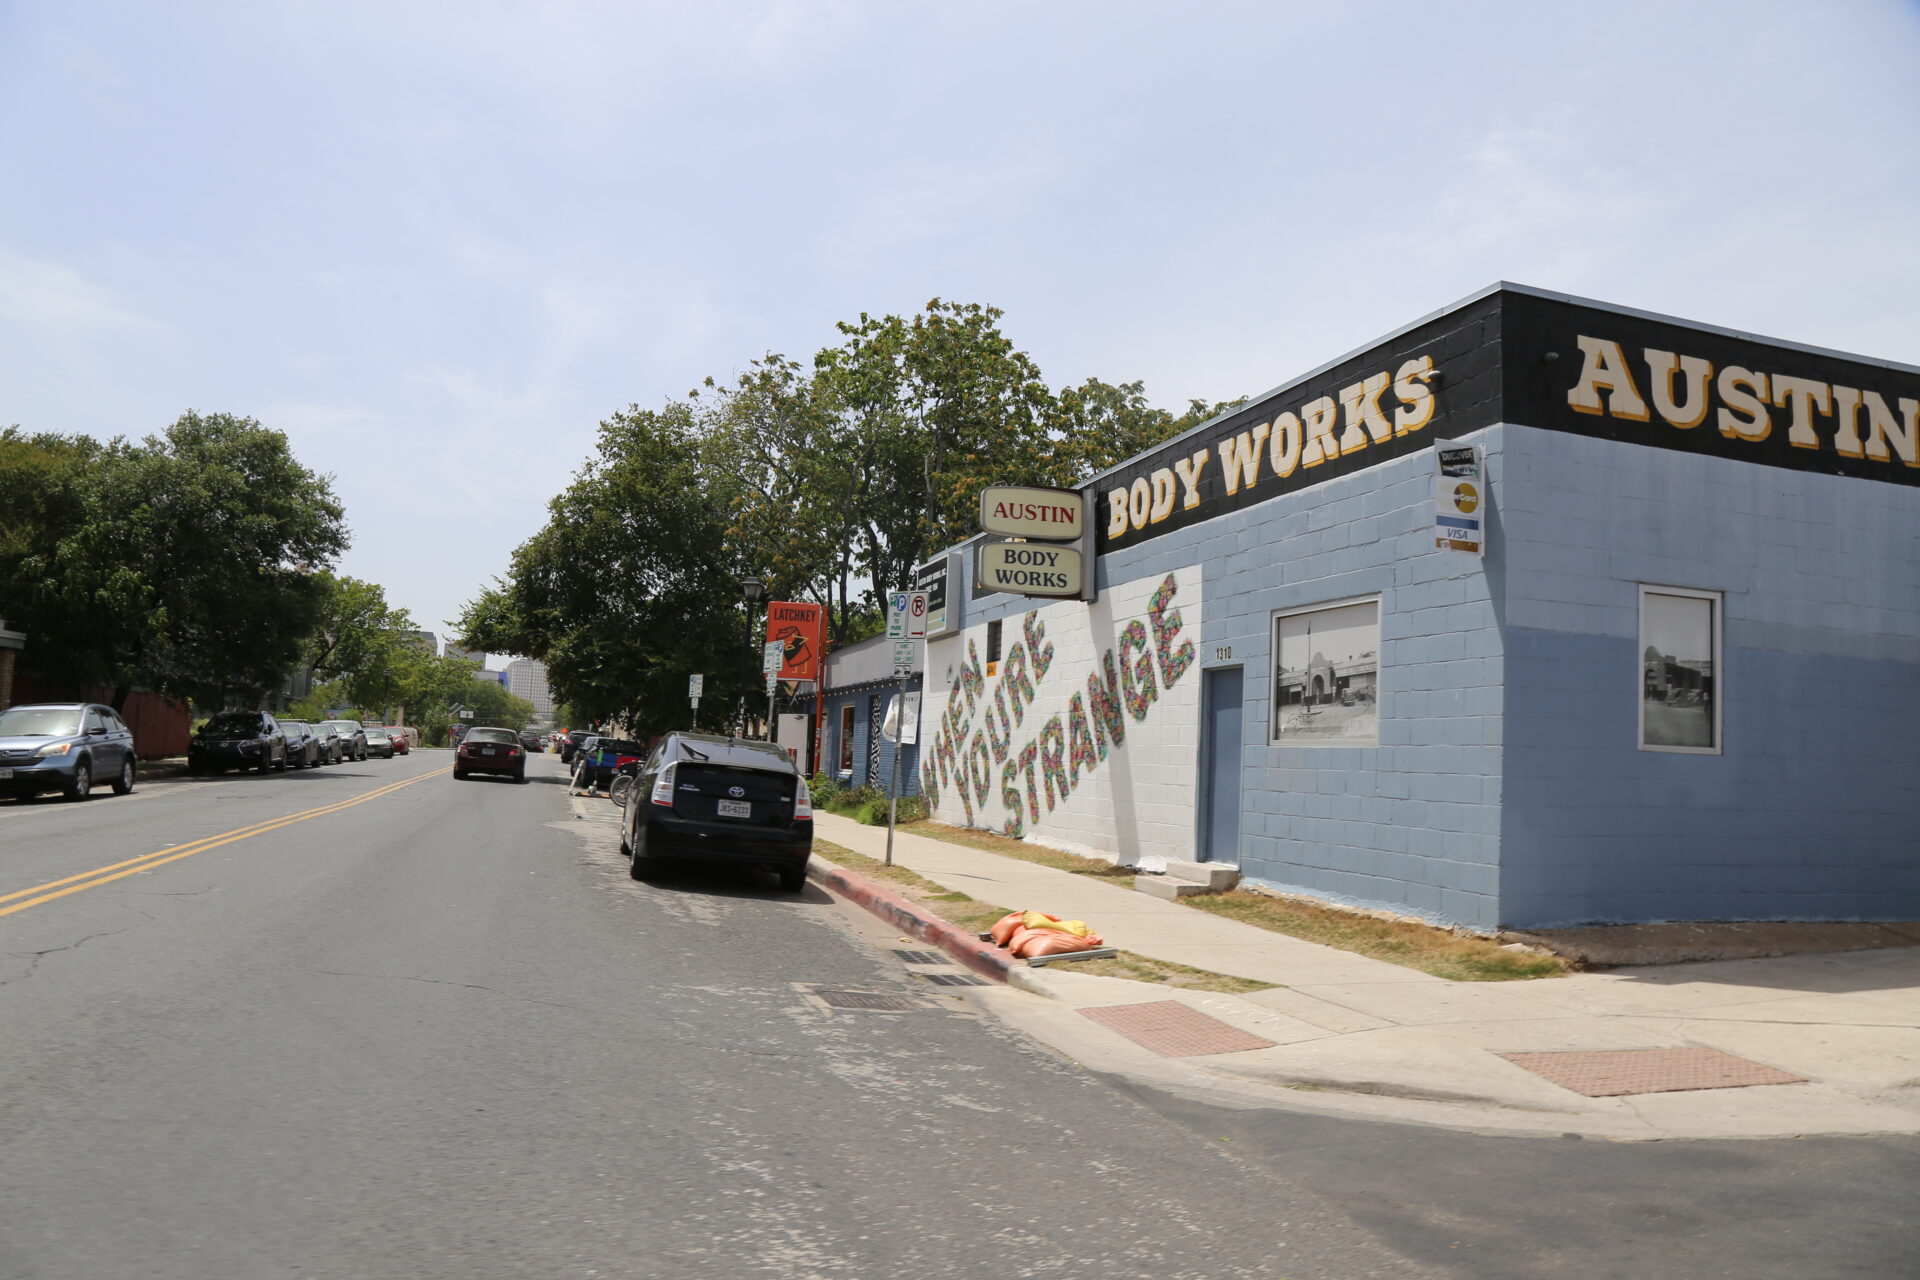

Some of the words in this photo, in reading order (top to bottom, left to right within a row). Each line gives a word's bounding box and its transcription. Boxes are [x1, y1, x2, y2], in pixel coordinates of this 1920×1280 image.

[1567, 334, 1920, 468] AUSTIN
[1107, 448, 1209, 539] BODY
[1219, 355, 1435, 496] WORKS
[993, 502, 1075, 524] AUSTIN
[1447, 528, 1468, 540] VISA
[1003, 549, 1059, 567] BODY
[995, 569, 1067, 588] WORKS
[774, 608, 815, 622] LATCHKEY
[1216, 646, 1232, 660] 1310
[1001, 573, 1195, 839] STRANGE
